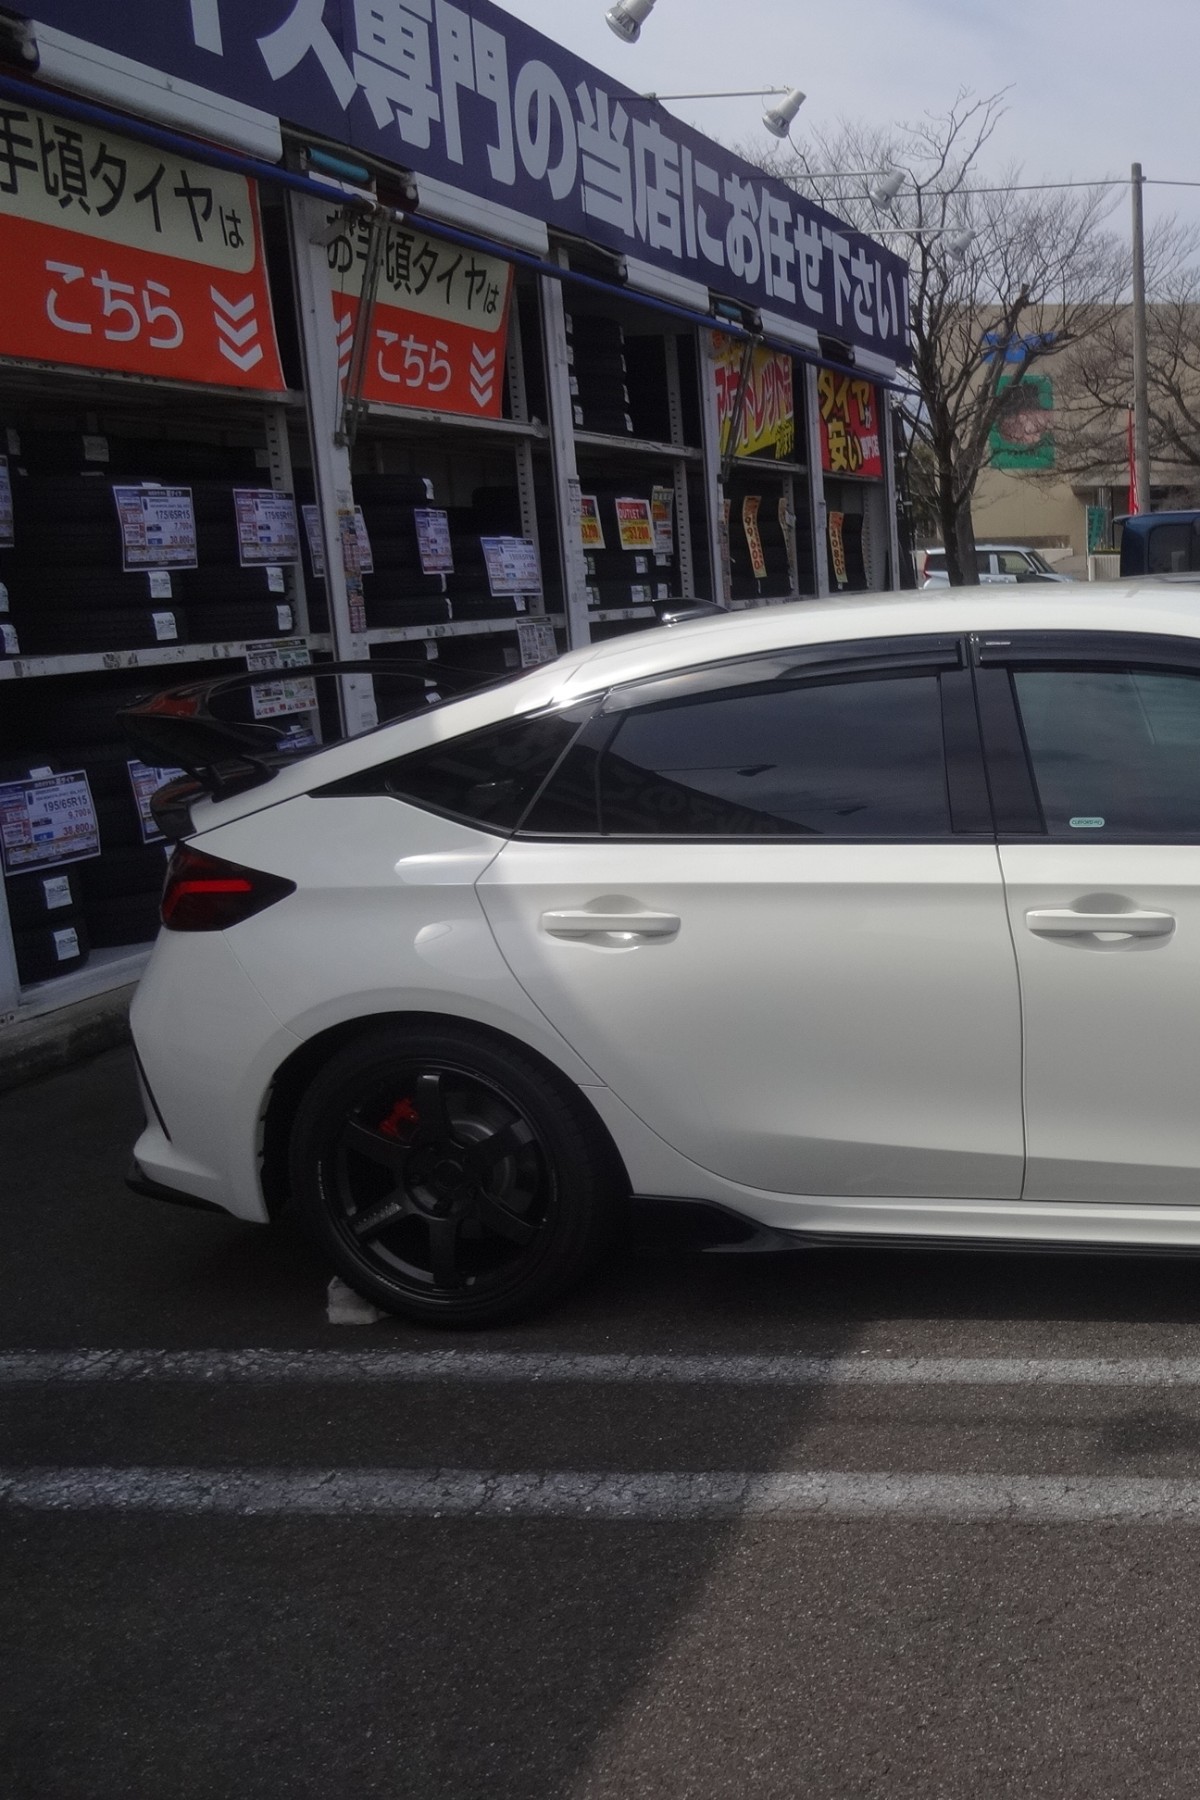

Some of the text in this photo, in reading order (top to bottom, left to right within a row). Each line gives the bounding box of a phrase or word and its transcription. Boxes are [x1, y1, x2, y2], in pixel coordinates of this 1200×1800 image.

[45, 260, 184, 349] こちら
[376, 329, 452, 392] こちら
[828, 417, 864, 472] 安い
[43, 794, 88, 813] 195/65R15
